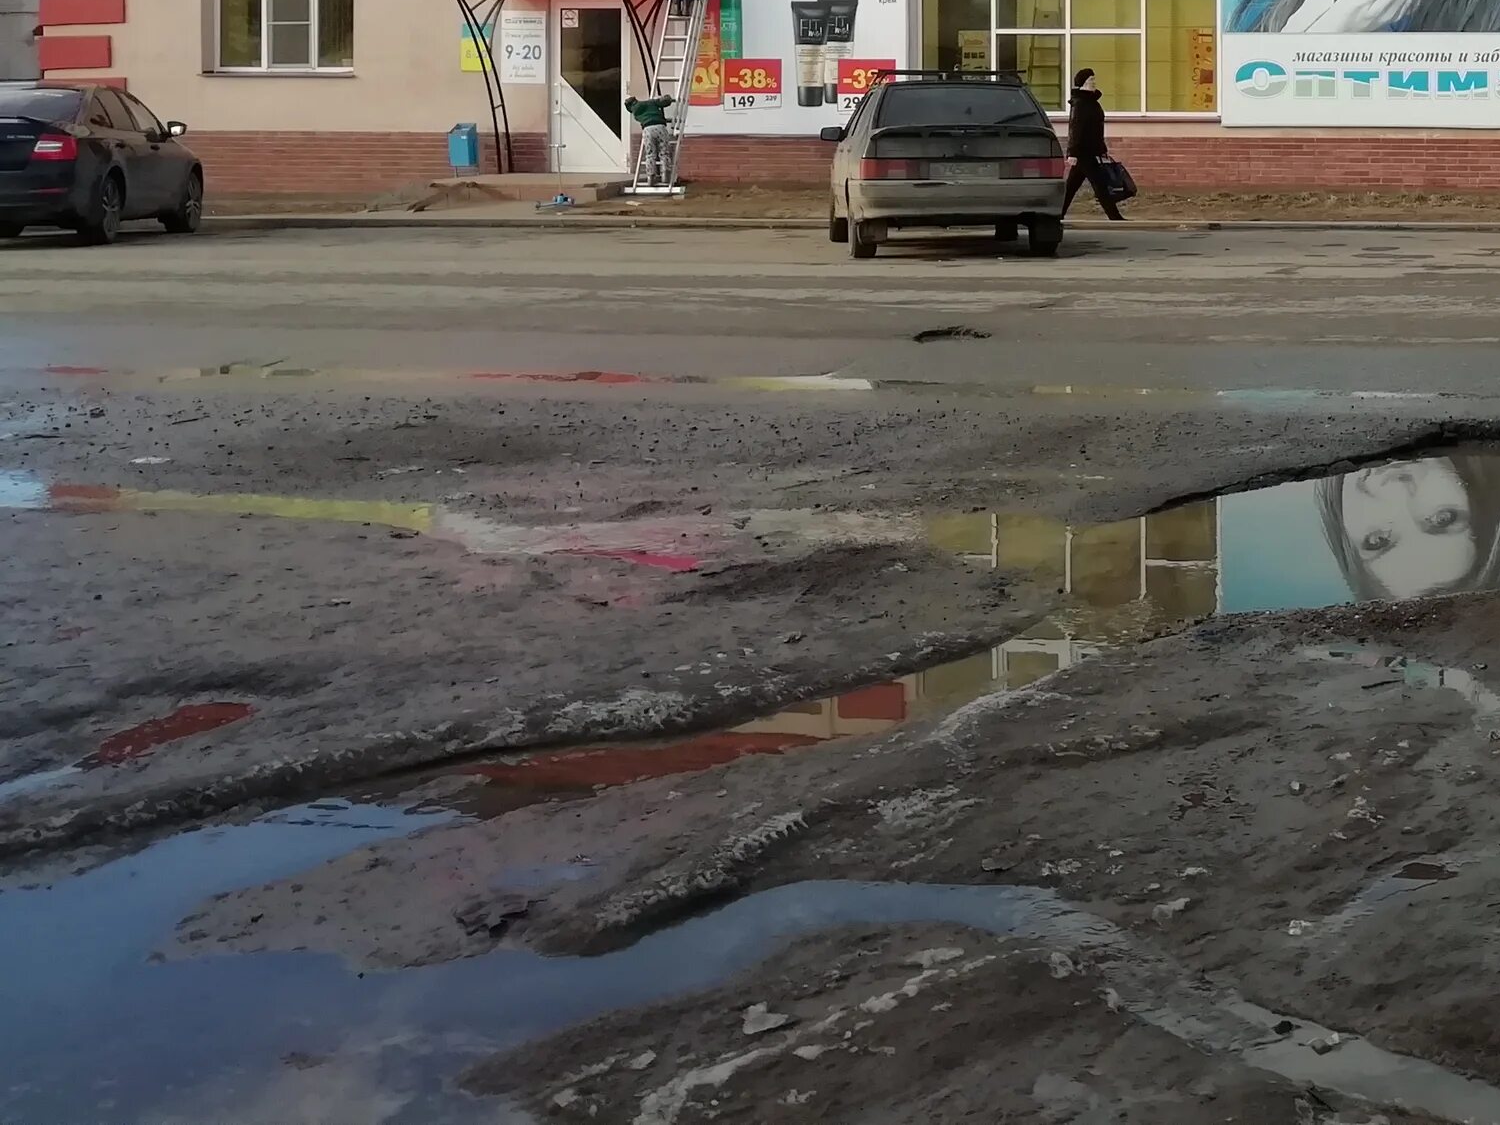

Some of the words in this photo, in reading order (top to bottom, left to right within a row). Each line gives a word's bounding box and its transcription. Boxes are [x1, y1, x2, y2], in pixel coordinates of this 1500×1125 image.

[505, 45, 542, 60] 9-20
[1292, 51, 1373, 63] магазины
[1378, 51, 1453, 66] красоты
[1458, 51, 1468, 63] и
[729, 68, 778, 89] -38%
[731, 95, 755, 108] 149
[844, 96, 865, 109] 29
